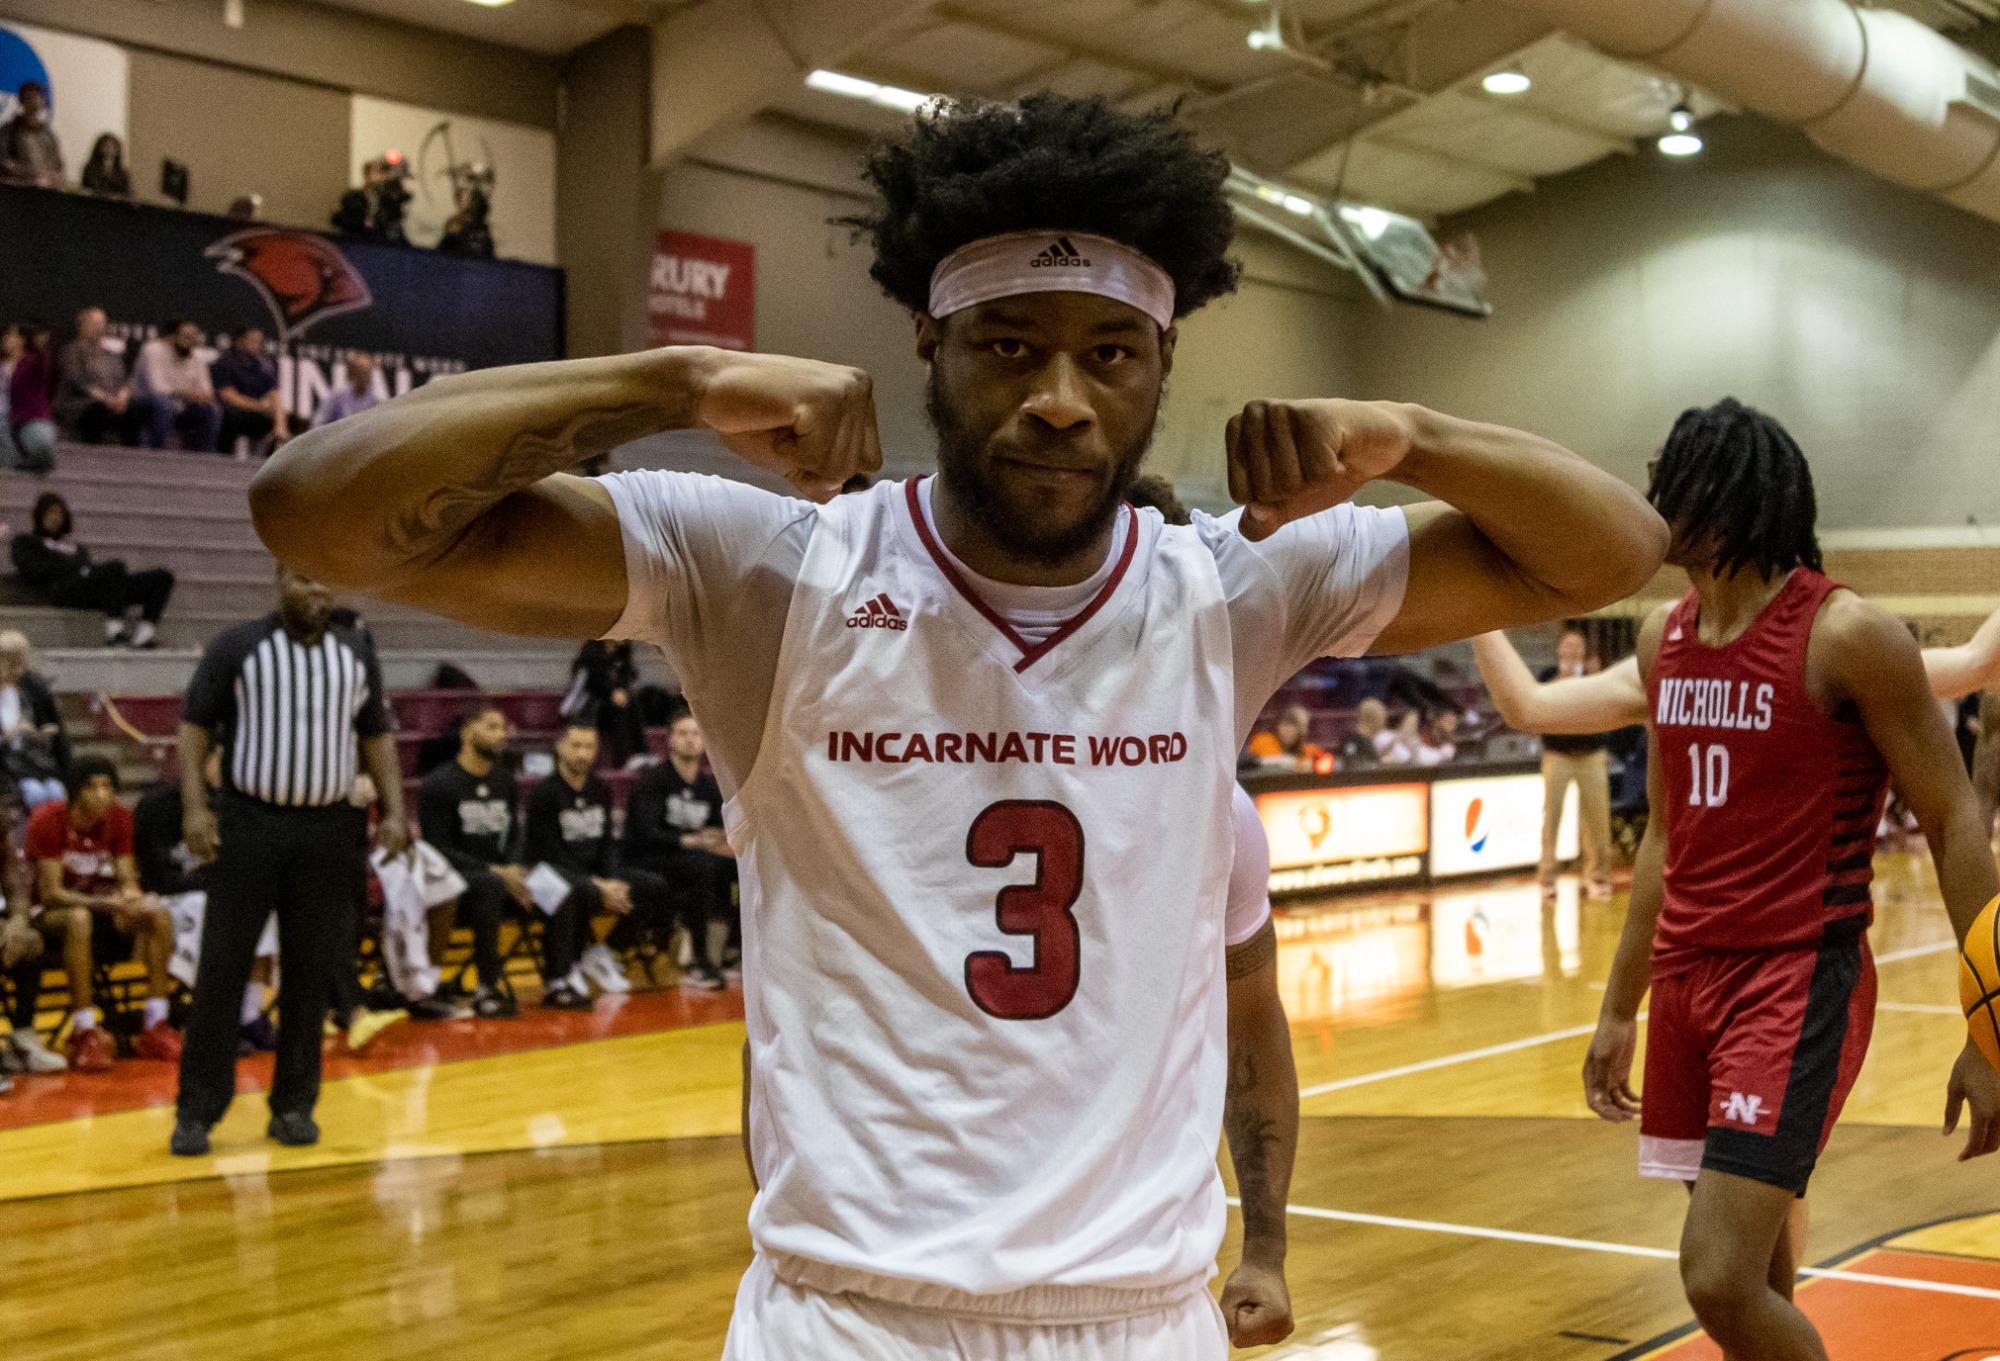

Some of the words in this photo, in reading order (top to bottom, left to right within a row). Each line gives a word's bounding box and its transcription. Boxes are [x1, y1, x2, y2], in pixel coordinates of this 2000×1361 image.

[1030, 256, 1091, 268] adidas
[846, 614, 908, 631] adidas
[1657, 678, 1774, 730] NICHOLLS
[827, 731, 1076, 765] INCARNATE
[1088, 731, 1188, 767] WORD
[1688, 743, 1730, 808] 10
[964, 798, 1085, 1021] 3
